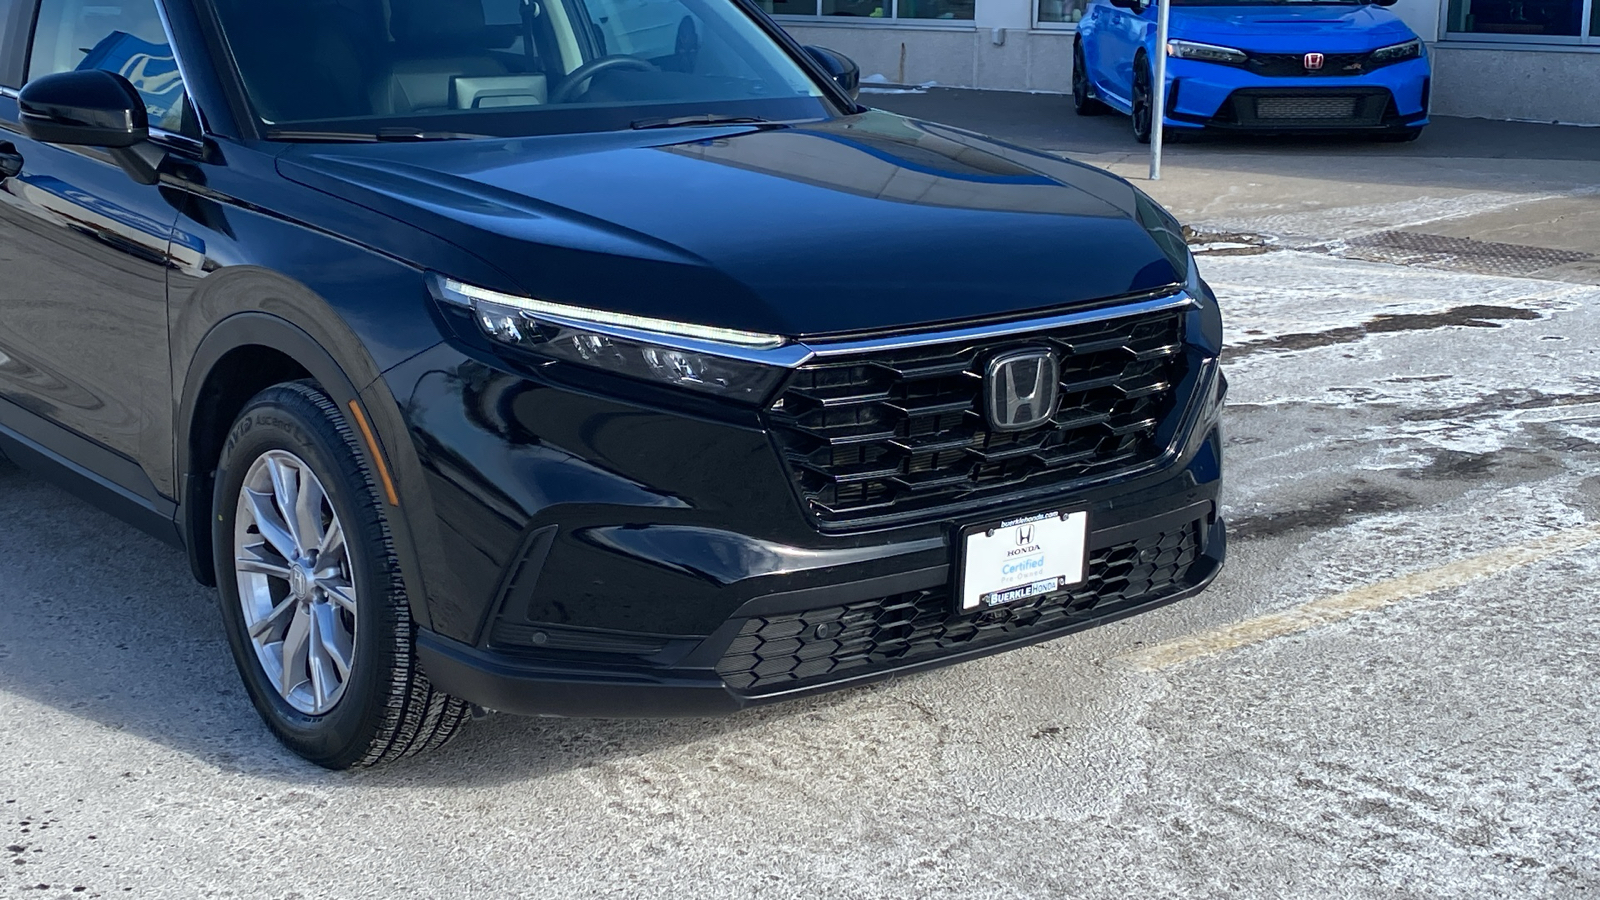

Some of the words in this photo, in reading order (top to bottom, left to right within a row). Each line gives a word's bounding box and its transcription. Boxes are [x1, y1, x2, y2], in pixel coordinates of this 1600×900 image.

[227, 416, 253, 457] AVID
[255, 414, 294, 433] Ascend
[1000, 511, 1059, 527] buerklehonda.com
[1006, 544, 1041, 557] HONDA
[1002, 556, 1045, 575] Certified
